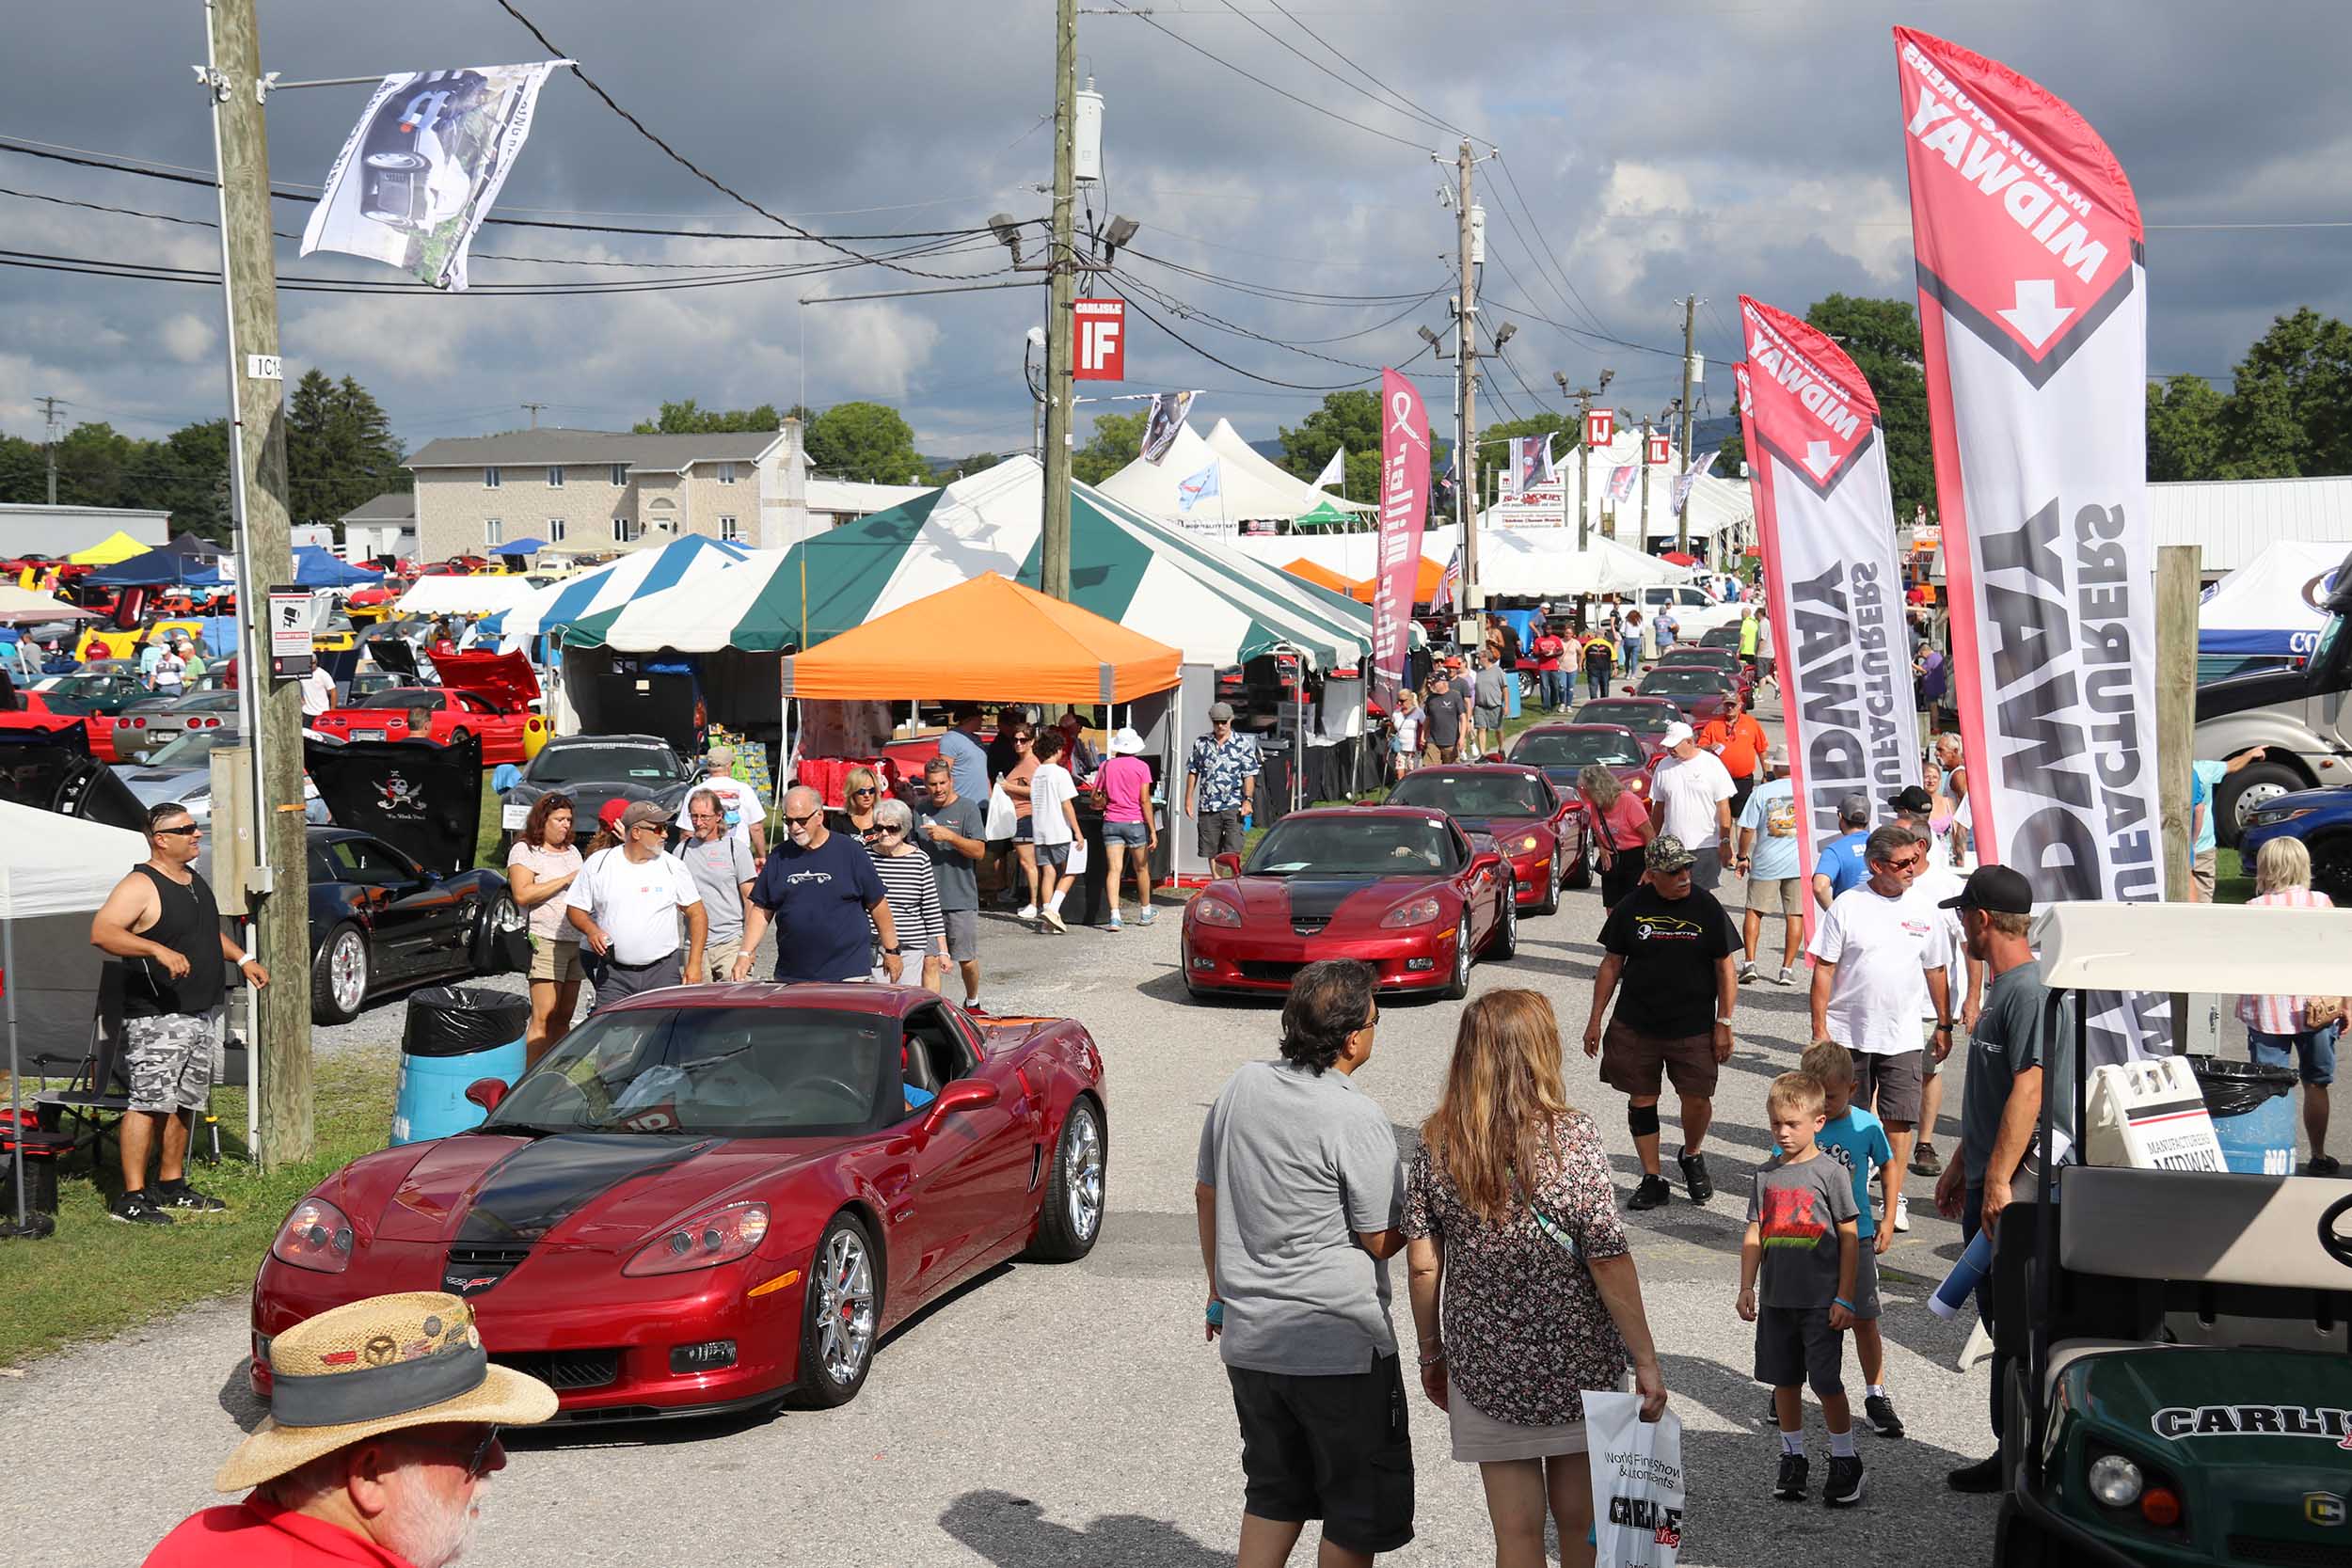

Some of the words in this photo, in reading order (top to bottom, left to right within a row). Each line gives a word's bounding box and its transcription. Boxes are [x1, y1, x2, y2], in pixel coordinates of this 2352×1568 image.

[1082, 321, 1120, 370] IF
[1592, 419, 1610, 443] IJ
[1651, 442, 1666, 462] IL
[2148, 1132, 2211, 1156] MANUFACTURERS
[2153, 1148, 2218, 1174] MIDWAY
[1604, 1451, 1633, 1465] World
